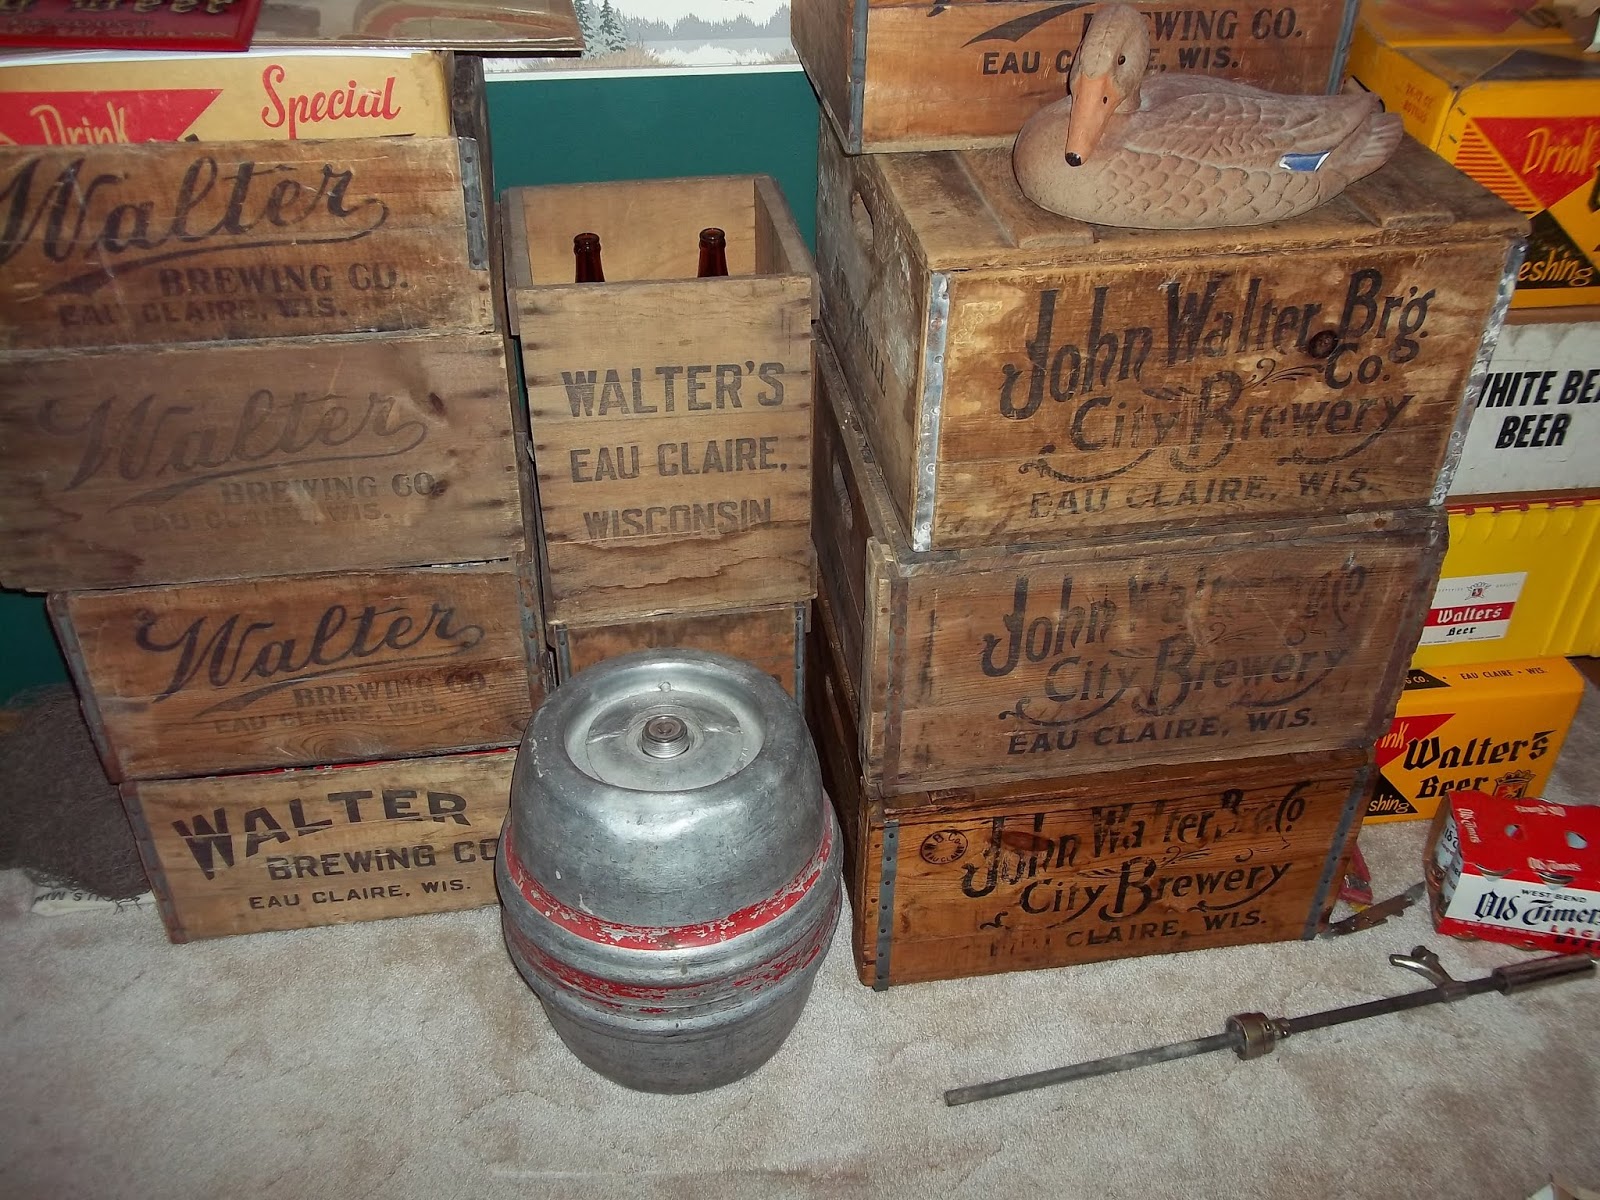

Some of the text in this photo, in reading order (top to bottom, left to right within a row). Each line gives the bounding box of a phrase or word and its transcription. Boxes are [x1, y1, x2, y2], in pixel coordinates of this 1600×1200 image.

[1082, 7, 1303, 41] WING CO.
[983, 51, 1041, 75] EAU
[1178, 47, 1240, 70] WIS.
[261, 64, 402, 140] Special
[30, 101, 129, 144] Drink
[1523, 126, 1600, 175] Drink
[0, 157, 389, 264] Walter
[160, 263, 334, 297] BREWING
[1519, 252, 1593, 287] eshing
[999, 284, 1154, 421] John
[1167, 279, 1324, 367] Walter
[1324, 343, 1391, 390] Co.
[561, 361, 785, 417] WALTER'S
[1557, 369, 1600, 405] BE
[38, 388, 428, 492] Walter
[1050, 371, 1414, 473] City Brewery
[1495, 413, 1572, 449] BEER
[569, 436, 789, 483] EAU CLAIRE,
[219, 475, 377, 505] BREWING
[1029, 486, 1108, 519] EAU
[583, 498, 772, 542] WISCONSIN
[981, 575, 1118, 677] John
[1446, 627, 1477, 637] Beer
[135, 601, 486, 703] Walter
[292, 675, 436, 708] BREWING
[1027, 633, 1349, 717] City Brewery
[1460, 672, 1478, 680] EAU
[1483, 669, 1514, 677] CLAIRE
[1007, 707, 1319, 757] EAU CLAIRE, WIS.
[1368, 793, 1410, 814] shing
[1415, 775, 1490, 799] Beer
[172, 788, 471, 881] WALTER
[268, 844, 437, 881] BREWING
[962, 811, 1080, 898] John
[249, 894, 301, 911] EAU
[421, 879, 472, 894] WIS.
[1019, 857, 1293, 922] City Brewery
[1474, 888, 1520, 921] Old
[1521, 889, 1587, 903] WEST BEND
[1202, 909, 1268, 932] WIS.
